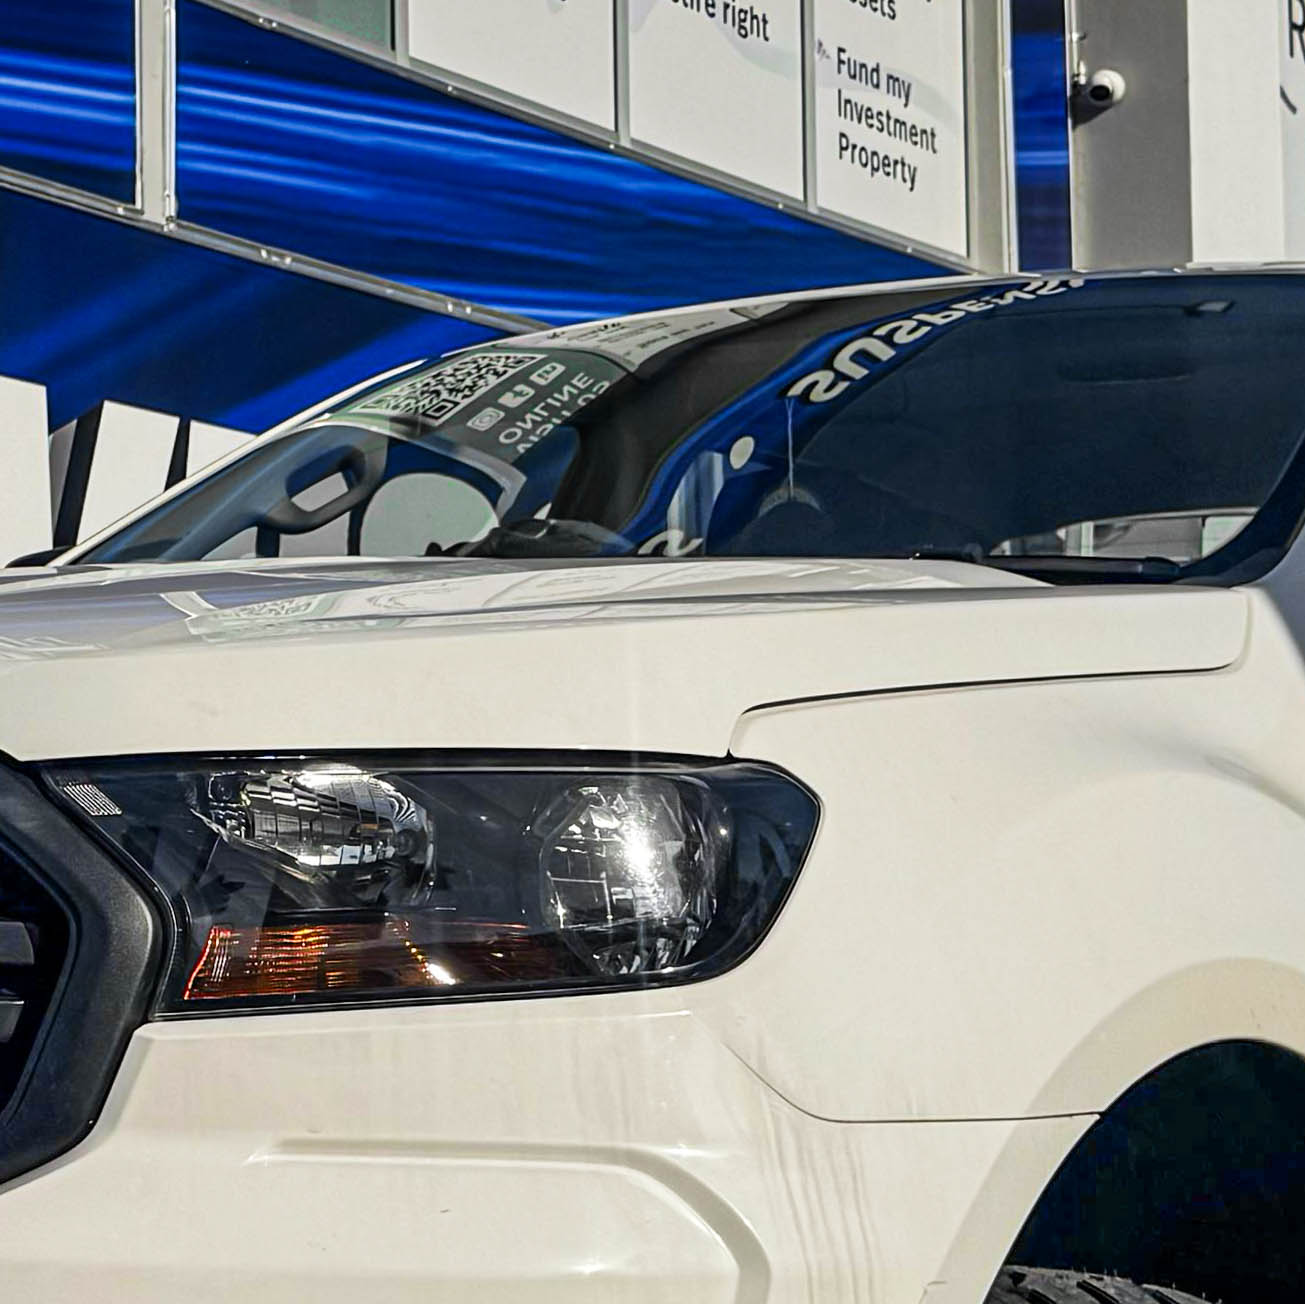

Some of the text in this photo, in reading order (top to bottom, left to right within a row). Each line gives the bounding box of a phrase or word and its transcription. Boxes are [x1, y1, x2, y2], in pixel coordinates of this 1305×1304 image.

[722, 0, 770, 42] right
[836, 46, 912, 108] Fund my
[837, 88, 937, 154] Investment
[837, 132, 918, 192] Property
